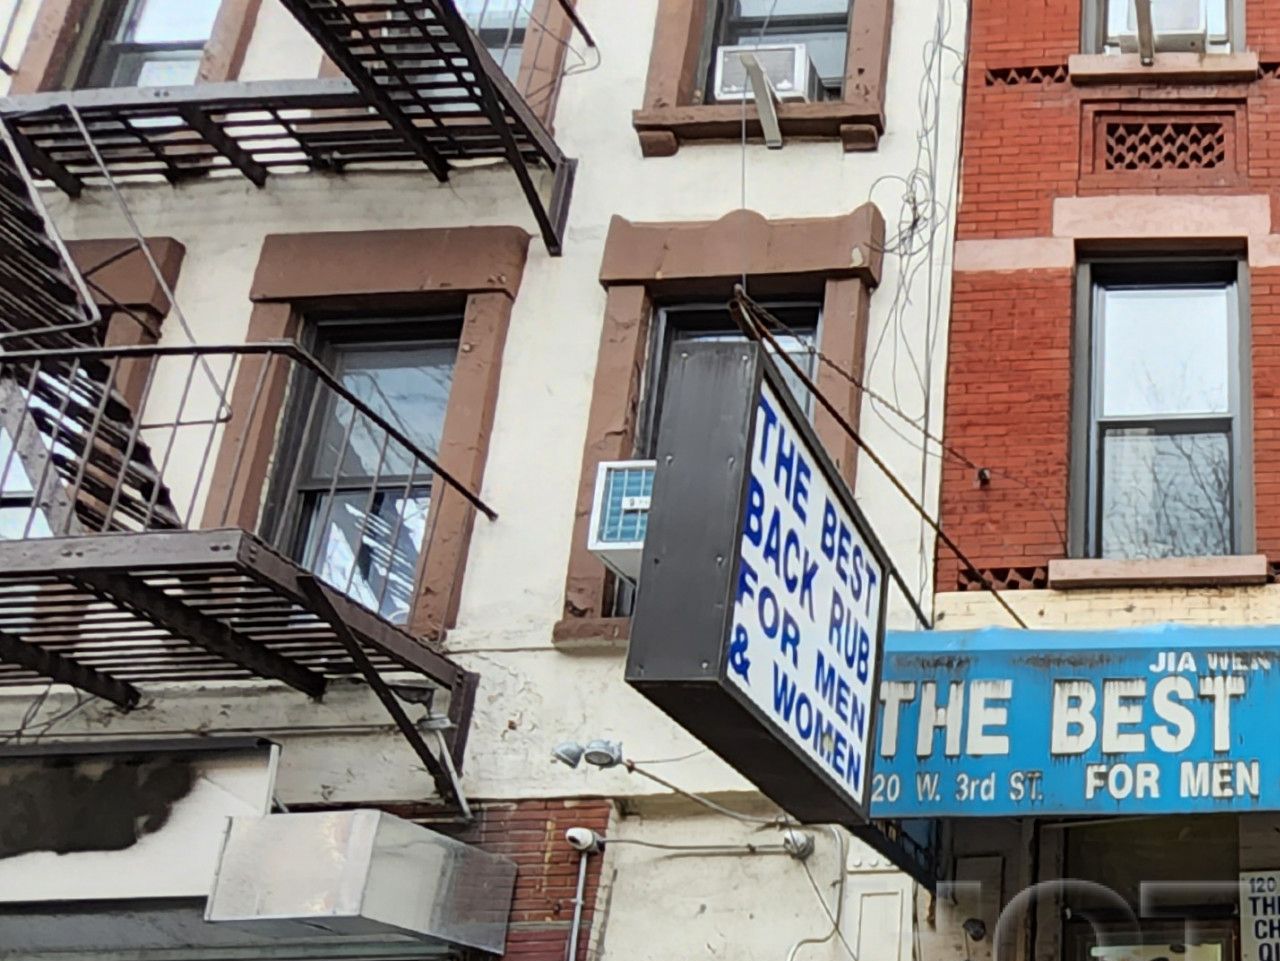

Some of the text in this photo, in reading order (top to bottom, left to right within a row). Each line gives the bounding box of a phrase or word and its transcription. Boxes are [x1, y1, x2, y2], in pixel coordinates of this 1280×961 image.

[758, 393, 877, 618] THE BEST
[742, 475, 870, 685] BACK RUB
[735, 557, 865, 742] FOR MEN
[1149, 651, 1197, 672] JIA
[728, 623, 861, 792] & WOMEN
[879, 680, 1013, 756] THE
[1050, 676, 1246, 755] BEST
[916, 773, 941, 801] W.
[955, 772, 996, 802] 3rd
[1010, 770, 1043, 801] ST.
[1085, 763, 1161, 800] FOR
[1179, 761, 1260, 798] MEN
[1250, 877, 1276, 894] 120
